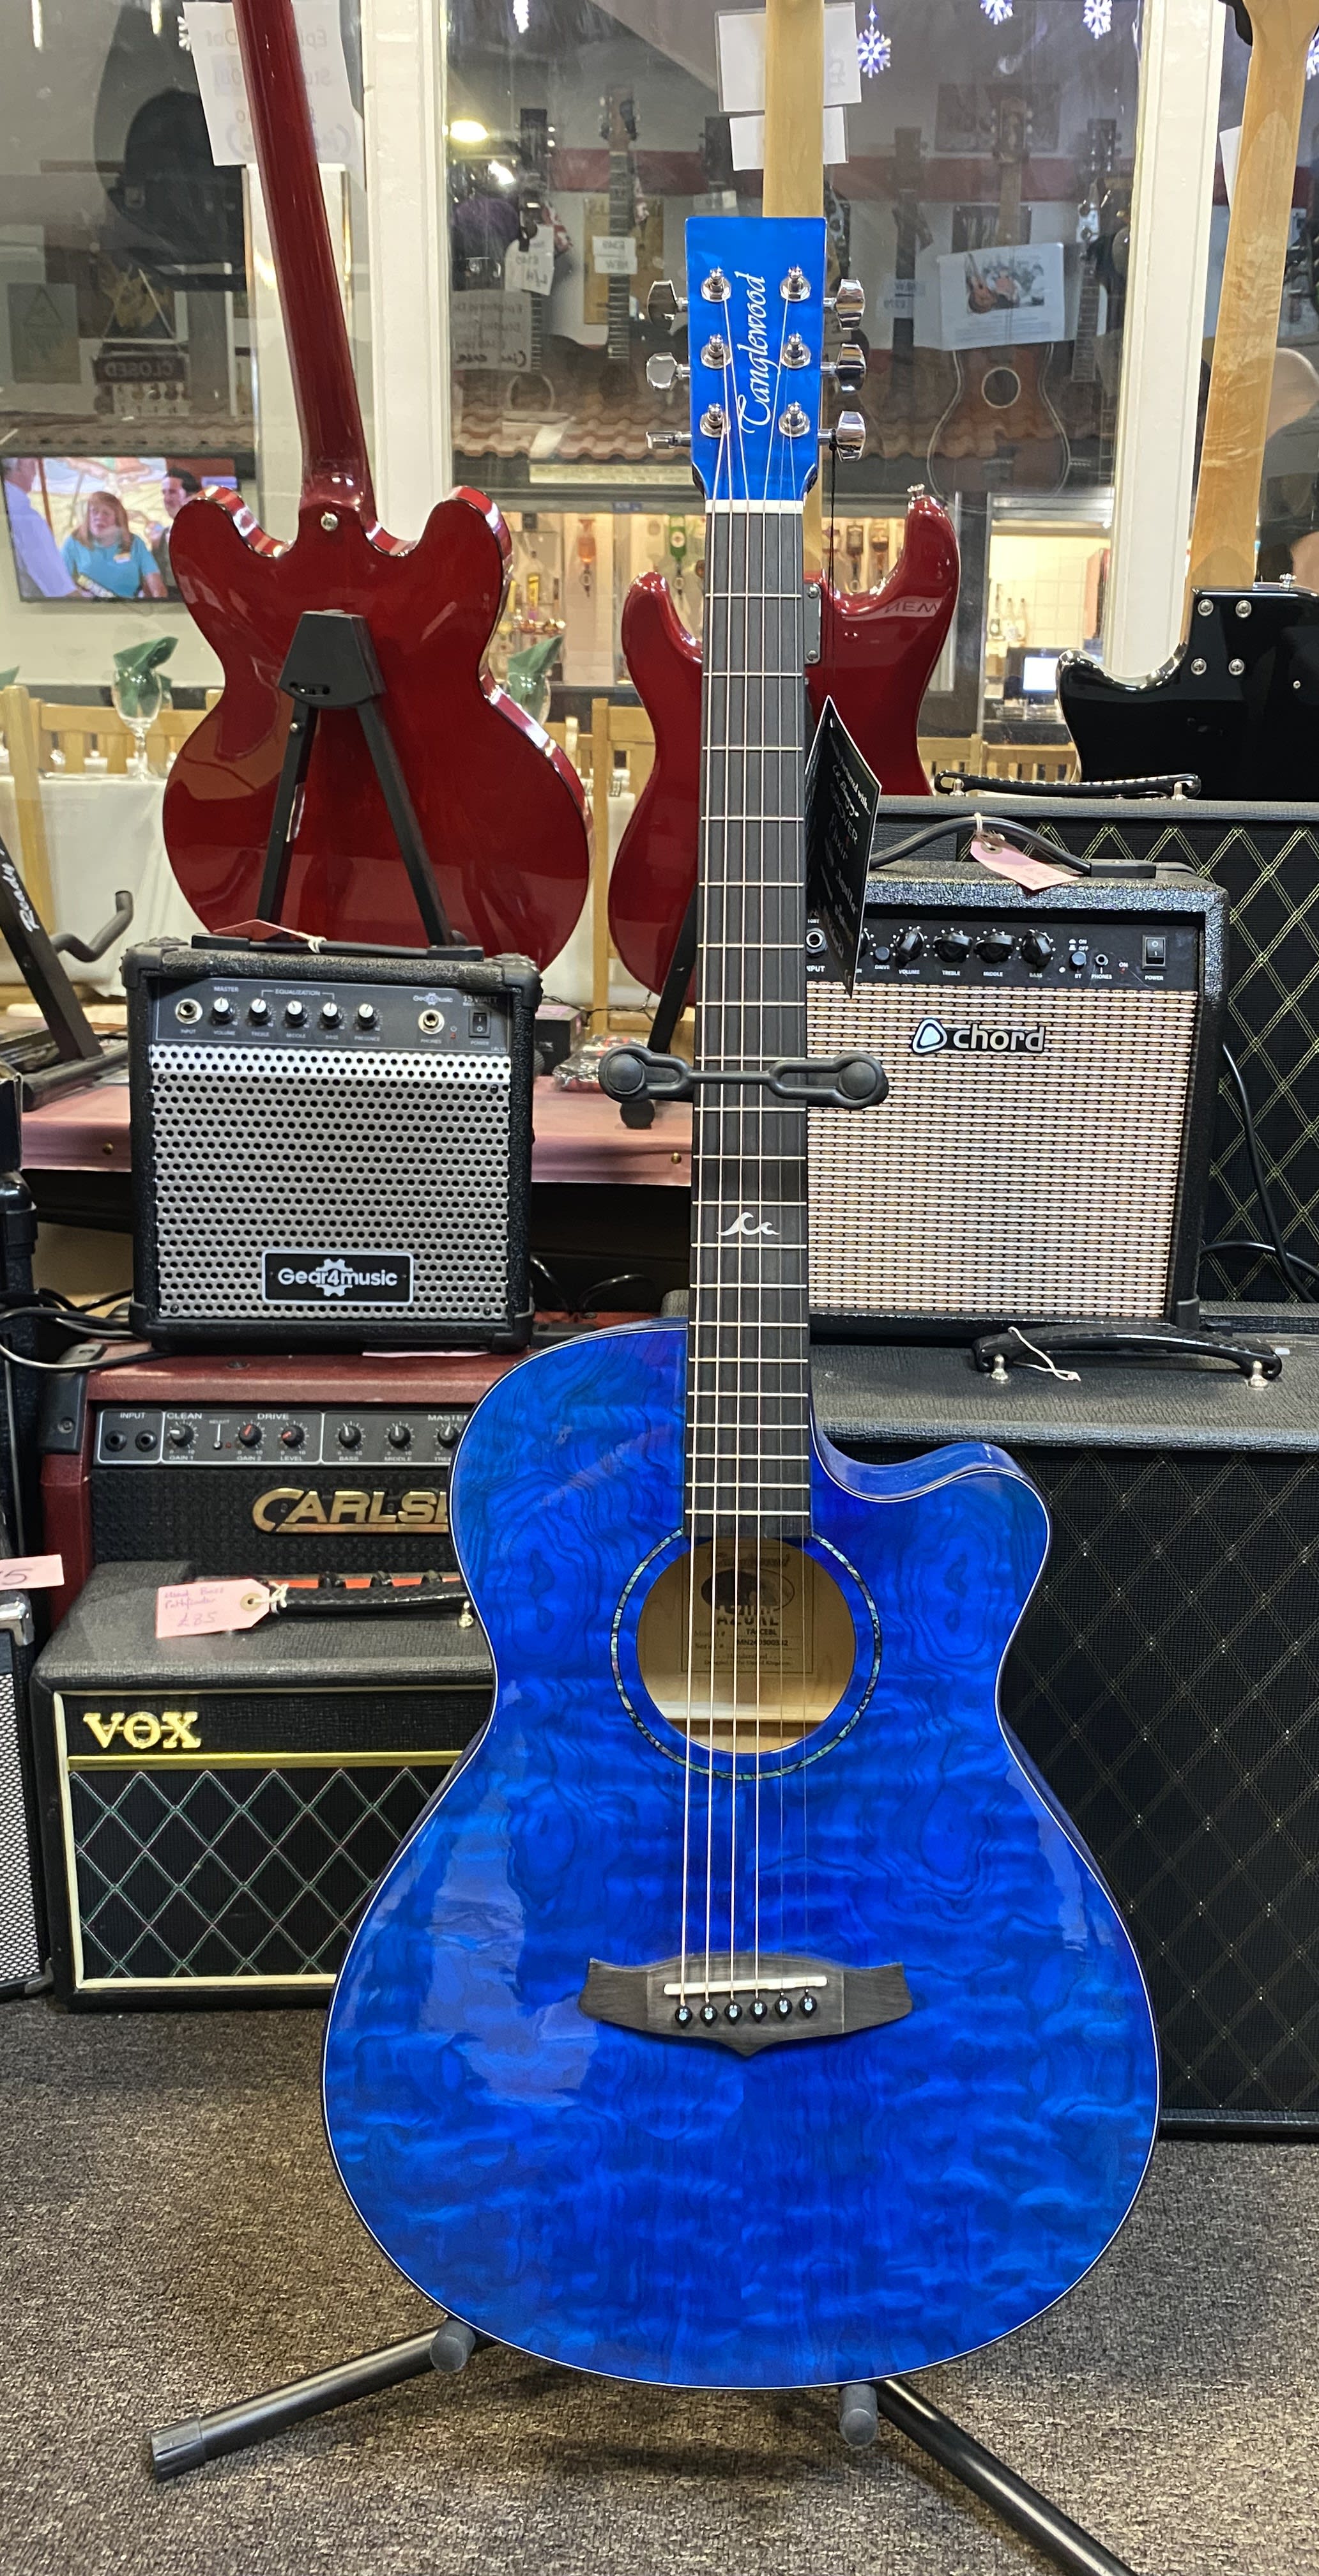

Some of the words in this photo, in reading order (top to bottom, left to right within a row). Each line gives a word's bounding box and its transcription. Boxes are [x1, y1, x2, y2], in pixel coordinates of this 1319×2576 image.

[734, 270, 781, 434] Tanglewood
[954, 1023, 1044, 1052] chord
[278, 1266, 397, 1287] Gear4music
[0, 1568, 33, 1585] 5
[82, 1711, 202, 1749] VOX
